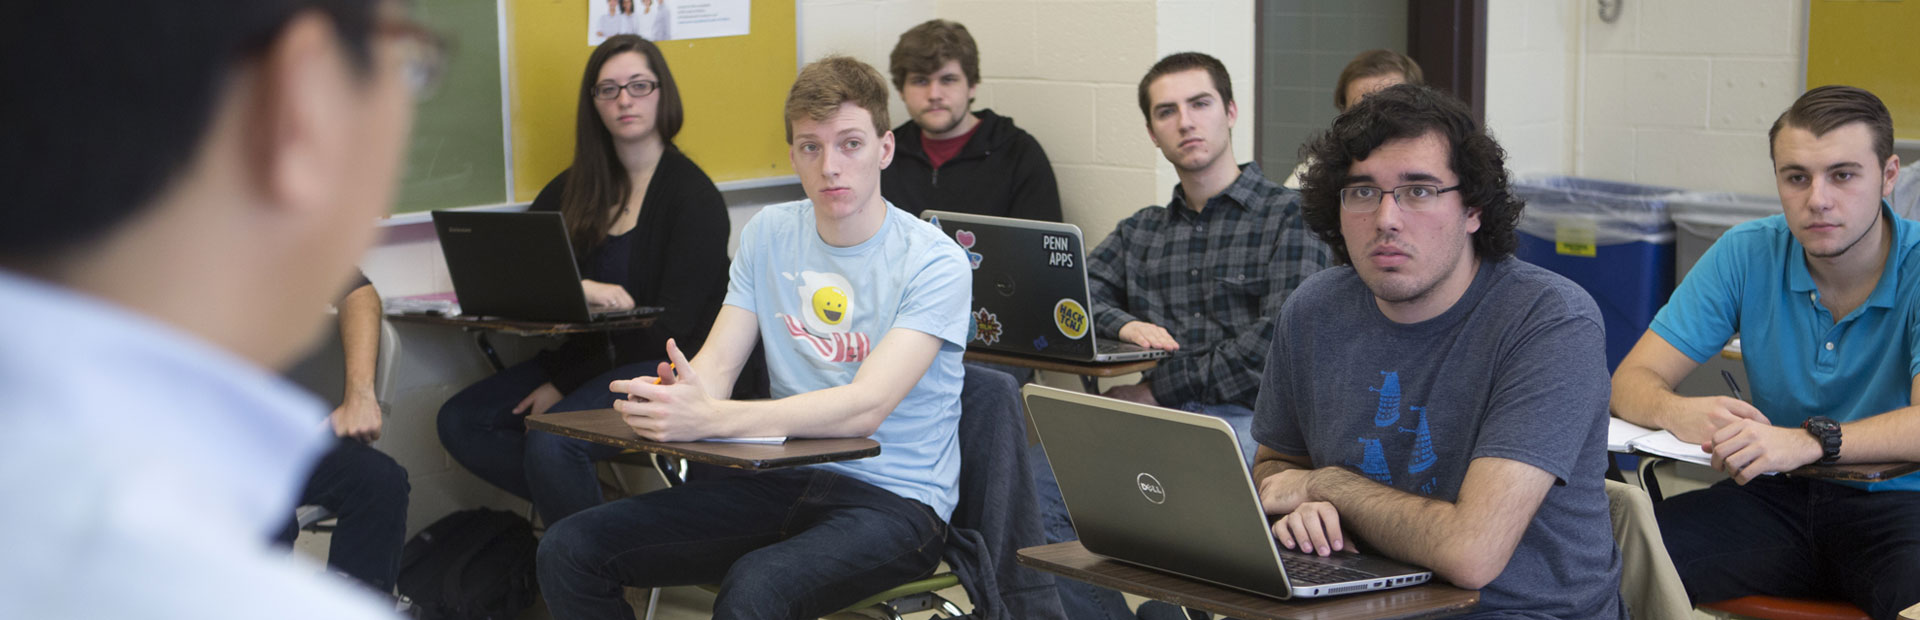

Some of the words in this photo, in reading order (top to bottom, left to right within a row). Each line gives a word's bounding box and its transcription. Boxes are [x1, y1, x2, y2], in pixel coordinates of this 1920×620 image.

[1043, 235, 1068, 251] PENN
[1049, 251, 1073, 268] APPS
[1060, 303, 1084, 325] HACK
[1140, 482, 1162, 494] DELL
